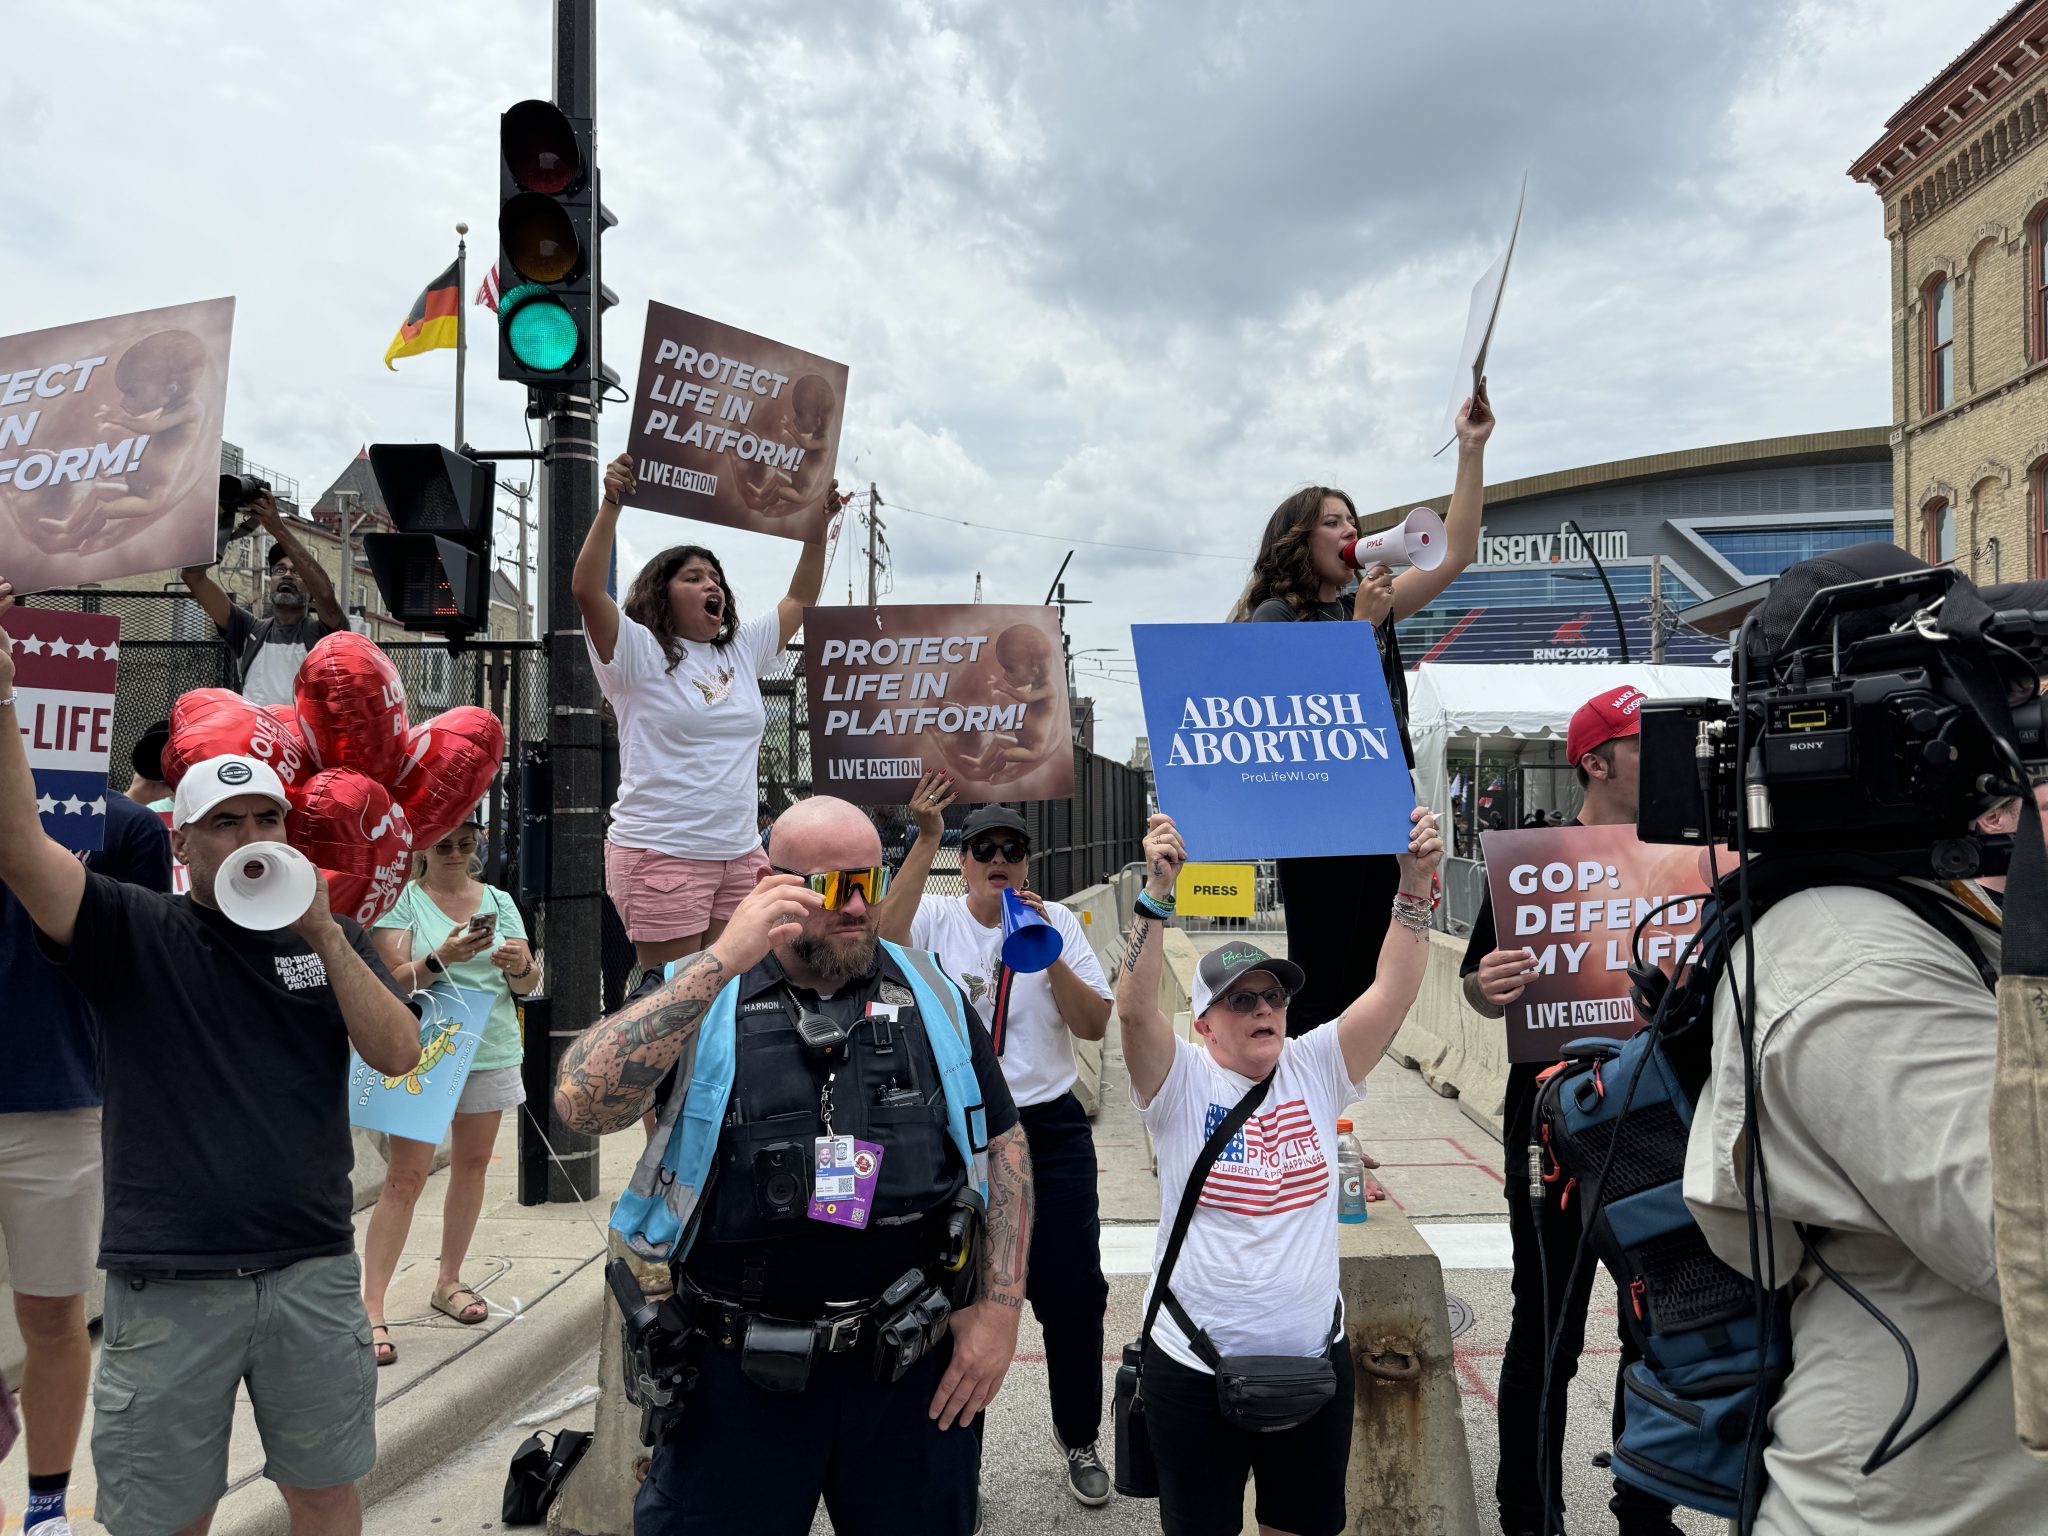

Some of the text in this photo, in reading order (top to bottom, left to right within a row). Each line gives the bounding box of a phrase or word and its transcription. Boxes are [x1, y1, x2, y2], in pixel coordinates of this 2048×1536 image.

[0, 356, 107, 406] ECT
[655, 339, 789, 399] PROTECT
[649, 375, 754, 425] LIFE IN
[644, 409, 805, 472] PLATFORM!
[1366, 538, 1383, 549] PYLE
[821, 636, 988, 666] PROTECT
[823, 672, 949, 702] LIFE IN
[1611, 690, 1635, 709] MAKE
[824, 703, 1028, 736] PLATFORM!
[1177, 693, 1367, 730] ABOLISH
[1165, 727, 1390, 767] ABORTION
[1790, 741, 1824, 751] SONY
[1241, 770, 1329, 784] ProLifeWI.org
[357, 865, 390, 923] OVE
[1193, 885, 1238, 896] PRESS
[1508, 861, 1620, 895] GOP:
[1515, 894, 1698, 936] DEFEND
[283, 966, 326, 984] PRO-LOVE
[1519, 941, 1591, 976] MY
[288, 975, 327, 990] PRO-LIFE
[744, 1001, 779, 1012] HARMON
[1222, 1163, 1262, 1176] LIBERTY
[1283, 1151, 1325, 1172] HAPPINESS
[1246, 1147, 1280, 1168] PRO
[1285, 1132, 1321, 1159] LIFE
